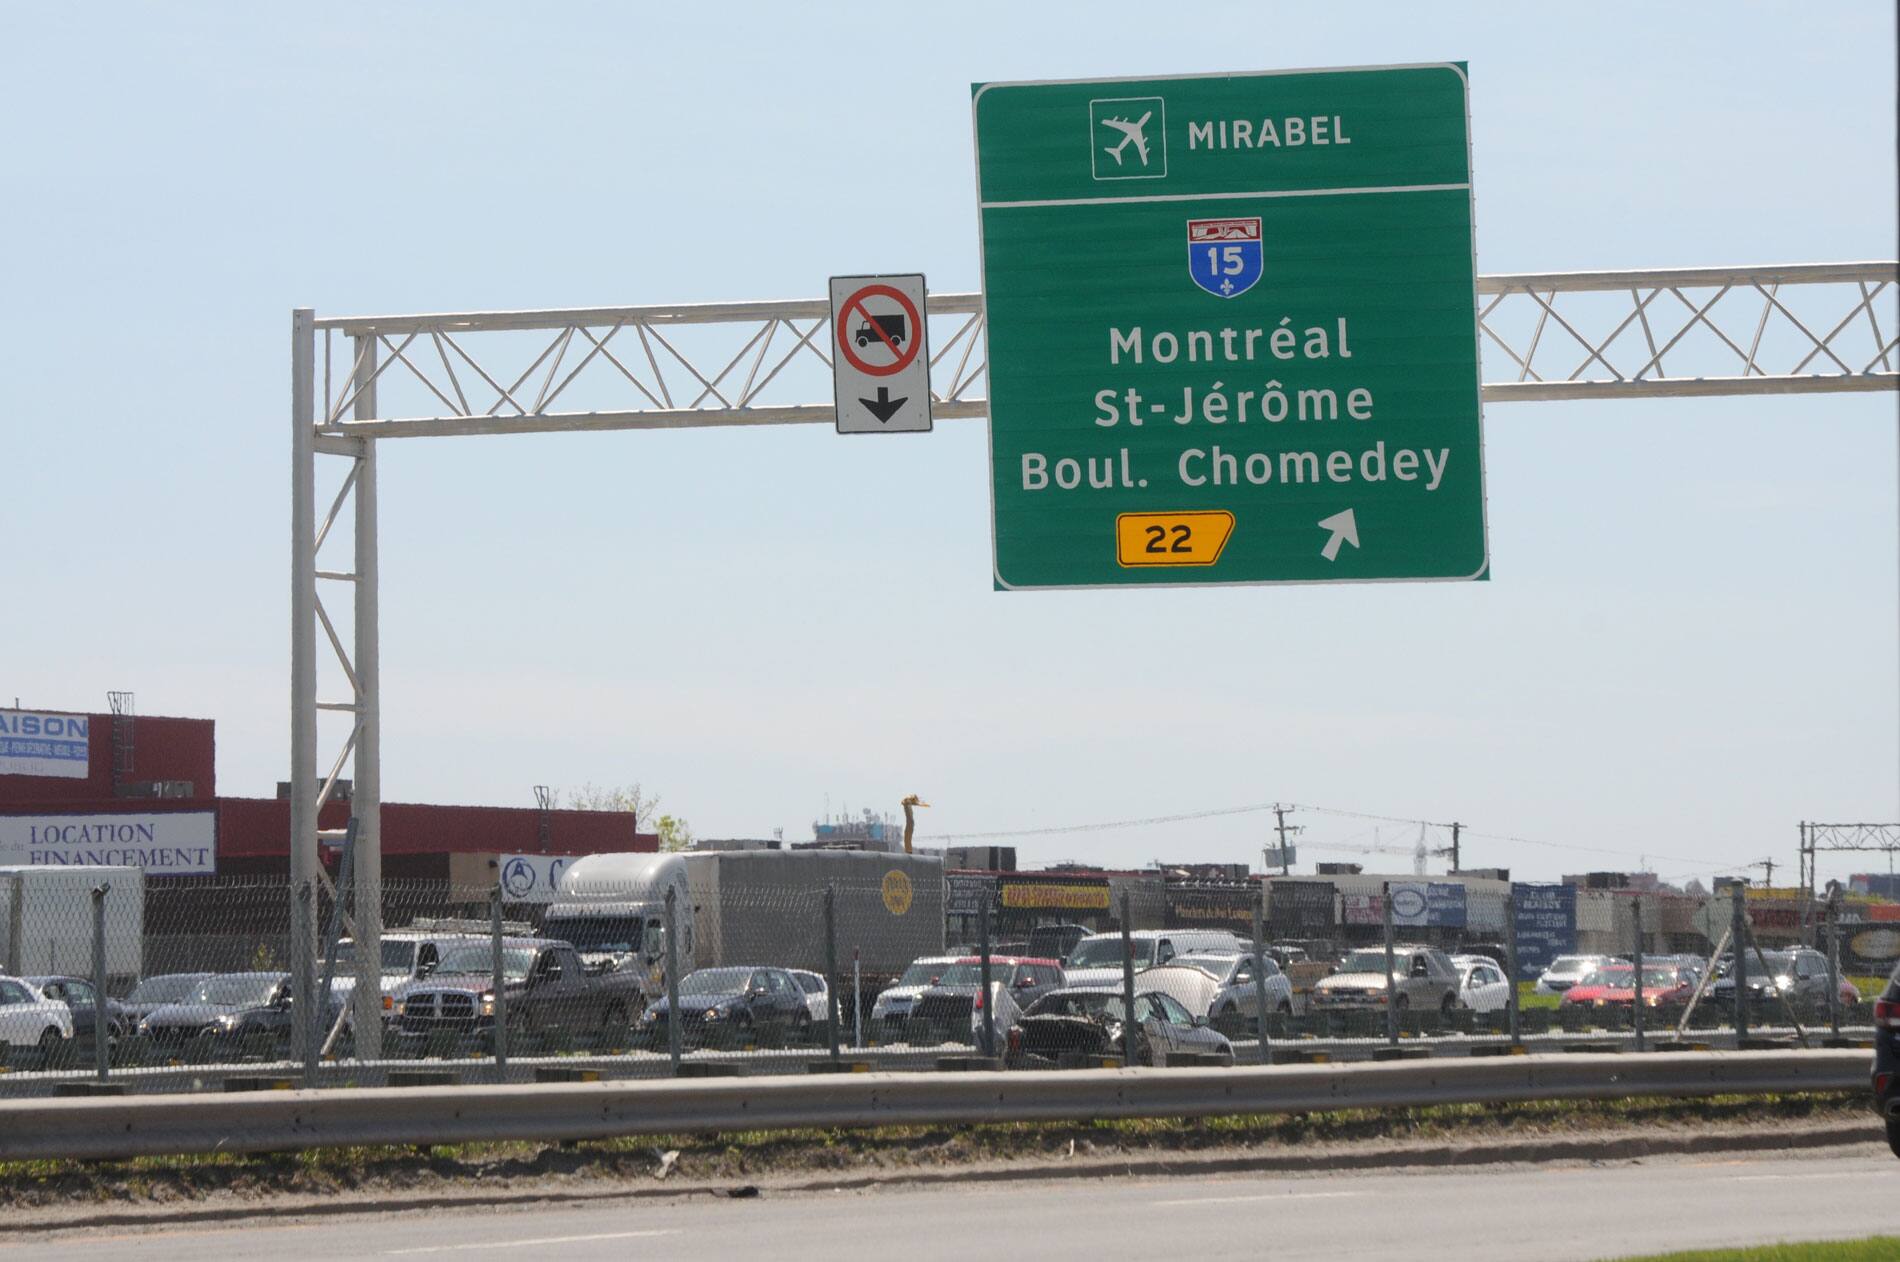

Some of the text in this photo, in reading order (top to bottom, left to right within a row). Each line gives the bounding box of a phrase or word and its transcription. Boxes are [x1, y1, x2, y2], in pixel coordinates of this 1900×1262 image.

[1188, 115, 1351, 150] MIRABEL
[1207, 246, 1244, 276] 15
[1110, 317, 1352, 365] Montréal
[1094, 379, 1373, 427] St-Jérôme
[1021, 441, 1450, 491] Boul. Chomedey
[1145, 525, 1192, 554] 22
[30, 823, 155, 845] LOCATION
[30, 848, 209, 866] FINANCEMENT
